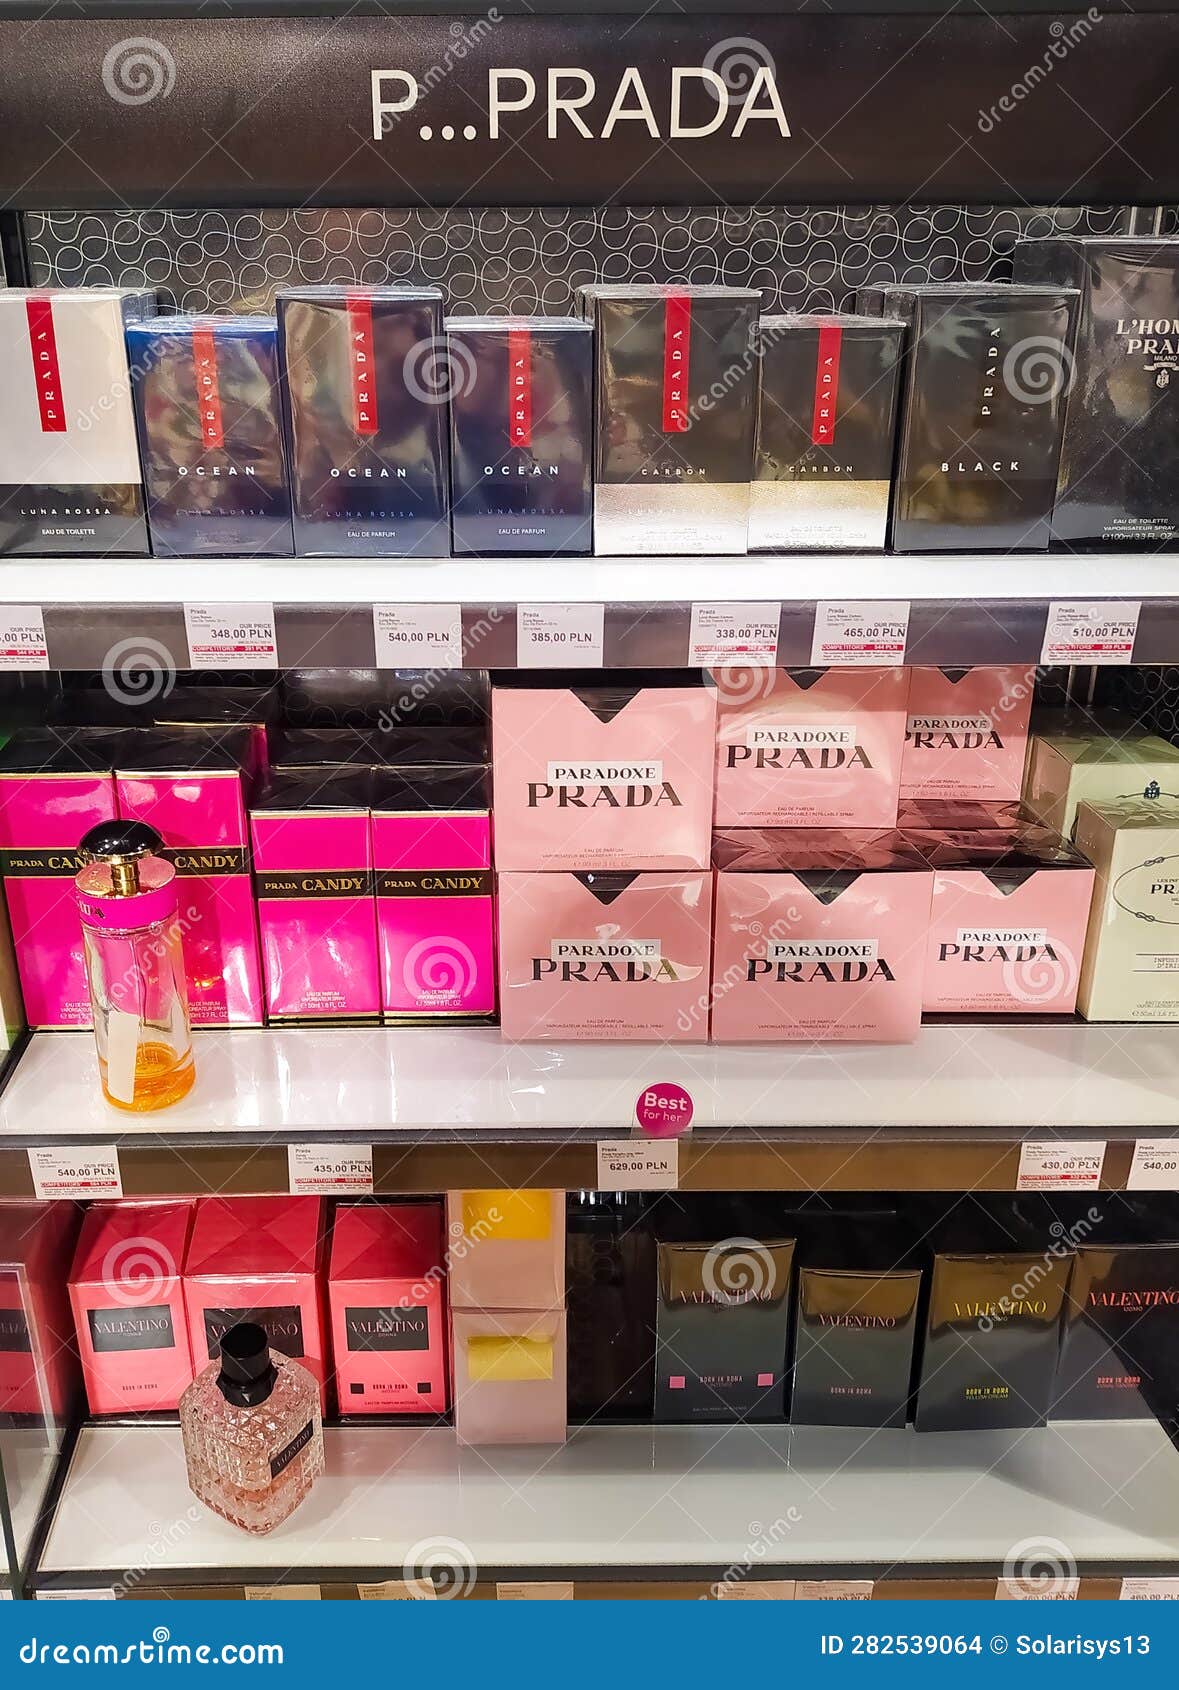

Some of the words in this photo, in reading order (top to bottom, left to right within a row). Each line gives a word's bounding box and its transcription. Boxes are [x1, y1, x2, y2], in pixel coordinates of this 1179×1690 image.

[1126, 338, 1179, 355] PRA
[37, 331, 57, 419] PRADA
[355, 331, 370, 422] PRADA
[670, 330, 683, 419] PRADA
[981, 327, 1001, 416] PRADA
[201, 358, 217, 437] PRADA
[515, 359, 525, 436] PRADA
[819, 357, 834, 434] PRADA
[178, 466, 256, 476] OCEAN
[484, 465, 559, 476] OCEAN
[641, 468, 706, 476] CARBON
[941, 461, 1019, 472] BLACK
[330, 468, 407, 478] OCEAN
[41, 528, 55, 536] EAU
[56, 528, 65, 536] DE
[66, 528, 96, 536] TOILETTE
[1160, 532, 1173, 540] OZ
[21, 633, 45, 642] PLN
[211, 629, 246, 639] 348,00
[249, 629, 272, 638] PLN
[388, 632, 424, 643] 540,00
[426, 633, 450, 642] PLN
[531, 632, 566, 643] 385,00
[569, 633, 592, 642] PLN
[716, 629, 751, 639] 338,00
[754, 629, 777, 638] PLN
[843, 628, 879, 638] 465,00
[882, 628, 906, 637] PLN
[1072, 627, 1108, 638] 510,00
[1111, 628, 1135, 637] PLN
[913, 719, 988, 729] PARADOXE
[753, 731, 850, 743] PARADOXE
[726, 745, 874, 769] PRADA
[555, 768, 657, 780] PARADOXE
[526, 782, 684, 808] PRADA
[10, 859, 45, 868] PRADA
[47, 856, 86, 870] CAN
[174, 855, 239, 869] CANDY
[264, 881, 298, 890] PRADA
[301, 877, 365, 891] CANDY
[383, 880, 418, 889] PRADA
[421, 877, 484, 890] CANDY
[962, 932, 1042, 942] PARADOXE
[558, 945, 655, 957] PARADOXE
[774, 945, 872, 957] PARADOXE
[937, 943, 1061, 962] PRADA
[531, 958, 681, 982] PRADA
[745, 958, 897, 983] PRADA
[644, 1091, 688, 1112] Best
[643, 1108, 661, 1120] for
[663, 1112, 683, 1123] her
[313, 1165, 347, 1174] 435,00
[350, 1165, 372, 1173] PLN
[609, 1162, 643, 1172] 629,00
[646, 1161, 668, 1170] PLN
[1041, 1161, 1075, 1171] 430,00
[1078, 1161, 1100, 1169] PLN
[1143, 1161, 1177, 1171] 540,00
[57, 1168, 91, 1178] 540,00
[93, 1168, 116, 1176] PLN
[678, 1288, 773, 1304] VALENTINO
[954, 1300, 1047, 1317] VALENTINO
[94, 1318, 169, 1334] VALENTINO
[350, 1321, 425, 1333] VALENTINO
[818, 1313, 896, 1329] VALENTINO
[965, 1387, 982, 1396] BORN
[992, 1387, 1009, 1395] ROMA
